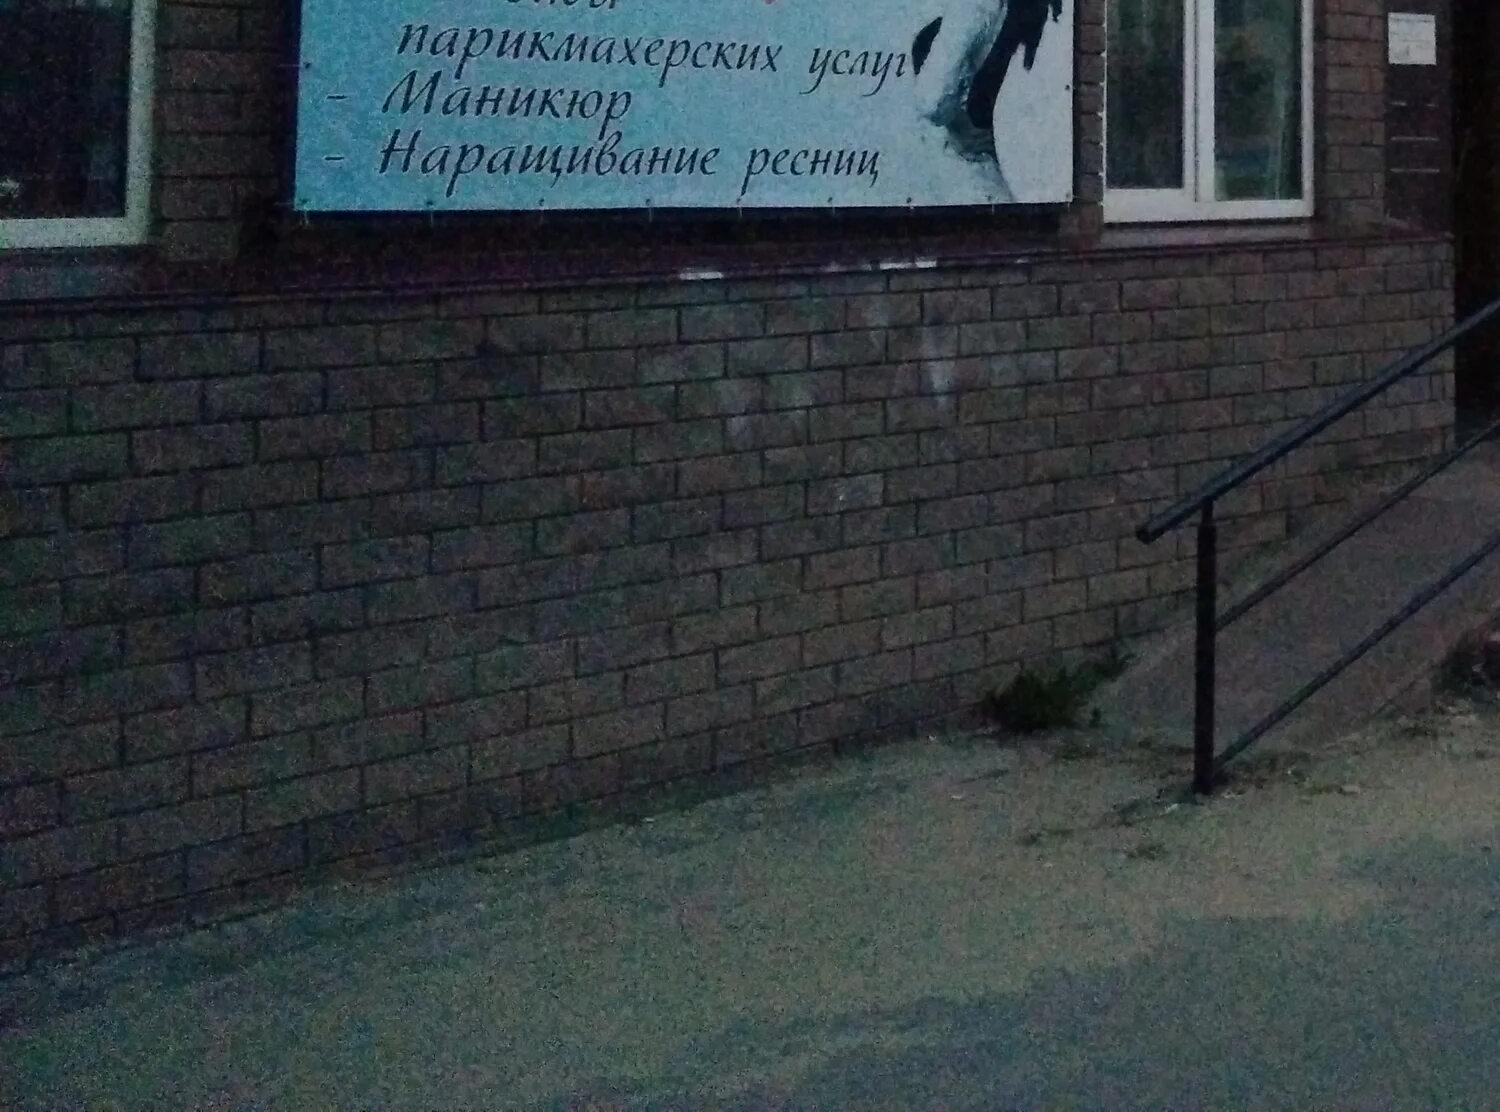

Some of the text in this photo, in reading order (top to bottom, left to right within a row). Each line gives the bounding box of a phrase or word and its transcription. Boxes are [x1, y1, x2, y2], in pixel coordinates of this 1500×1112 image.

[396, 23, 906, 96] парикмахерских услуг
[381, 70, 631, 141] Маникюр
[379, 129, 718, 198] Наращивание
[742, 144, 880, 195] ресниц
